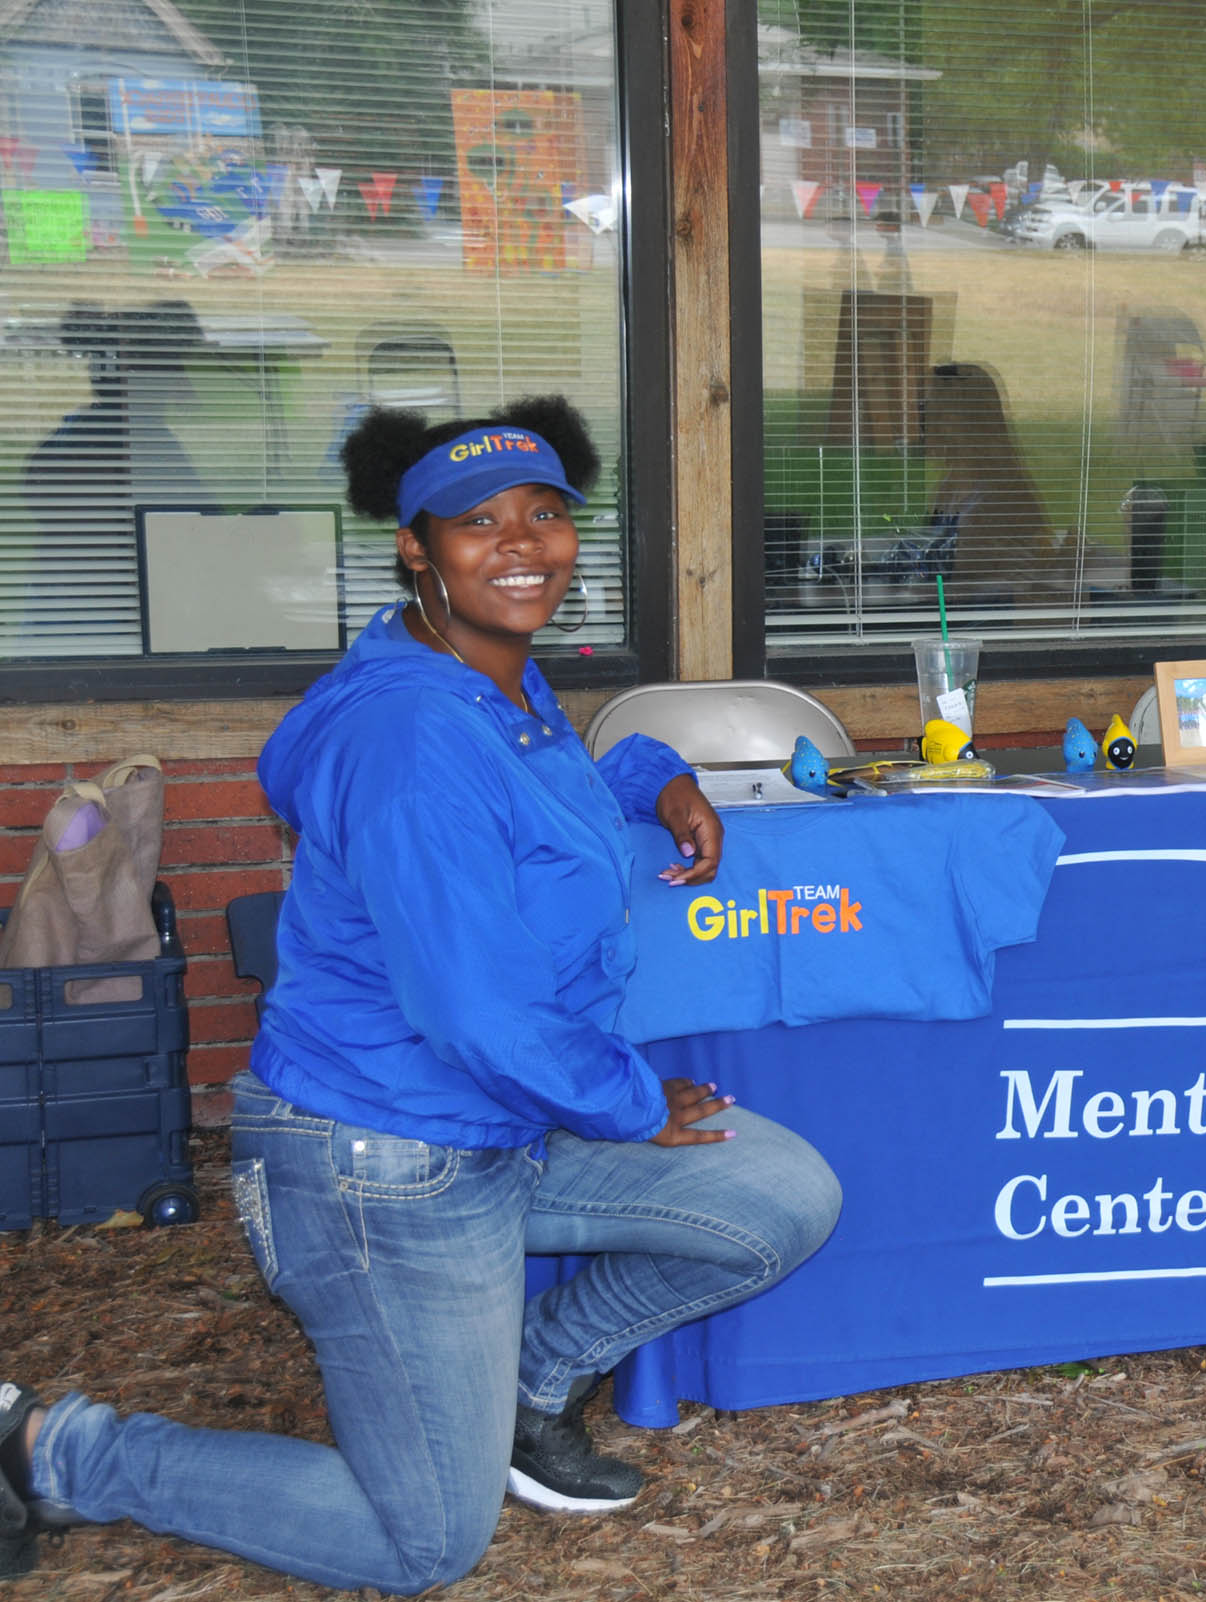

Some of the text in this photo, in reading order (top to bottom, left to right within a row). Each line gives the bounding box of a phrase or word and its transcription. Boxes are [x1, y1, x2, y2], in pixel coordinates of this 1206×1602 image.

[449, 434, 539, 462] GirlTrek
[793, 885, 840, 900] TEAM
[687, 888, 863, 941] GirlTrek
